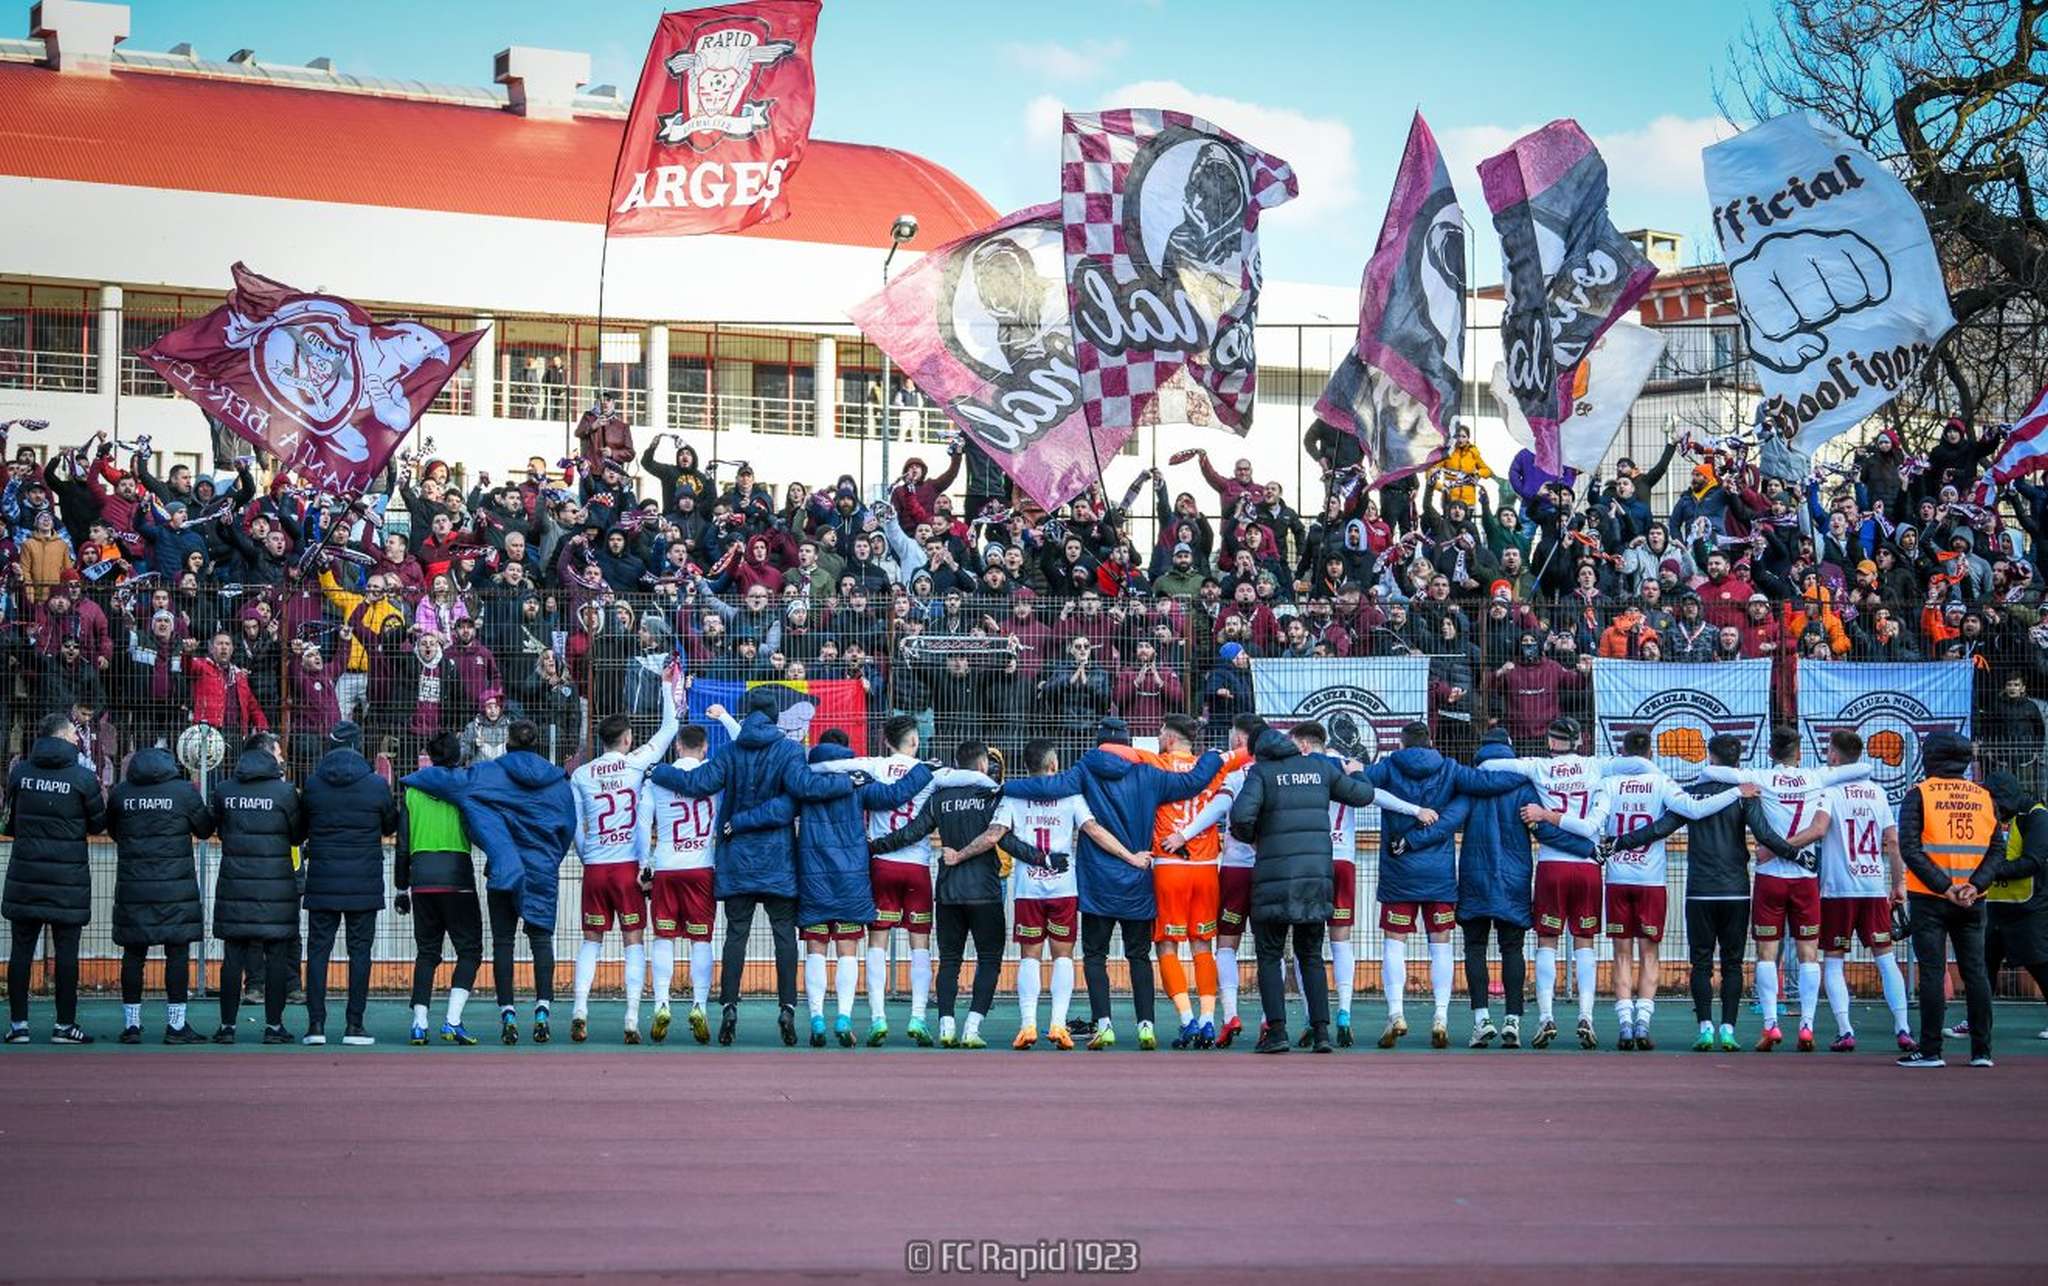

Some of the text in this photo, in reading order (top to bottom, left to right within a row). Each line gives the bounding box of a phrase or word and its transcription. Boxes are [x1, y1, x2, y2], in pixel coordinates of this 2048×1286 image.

[701, 31, 752, 50] RAPID
[1303, 690, 1380, 712] PELUZA NORD
[1642, 693, 1722, 715] PELUZA NORD
[1846, 694, 1925, 718] PELUZA NORD
[1277, 773, 1321, 785] FC RAPID
[1550, 763, 1582, 778] Ferroli
[21, 777, 71, 794] FC RAPID
[1619, 780, 1653, 795] Ferroli
[1845, 784, 1876, 799] Ferroli
[124, 798, 173, 810] FC RAPID
[224, 797, 273, 810] FC RAPID
[594, 788, 636, 835] 23
[941, 799, 985, 813] FC RAPID
[1548, 791, 1588, 819] 27
[670, 796, 713, 842] 20
[1779, 800, 1804, 841] 7
[610, 831, 632, 842] DSC
[1947, 819, 1974, 840] 155
[1845, 818, 1879, 862] 14
[1860, 864, 1880, 874] DSC
